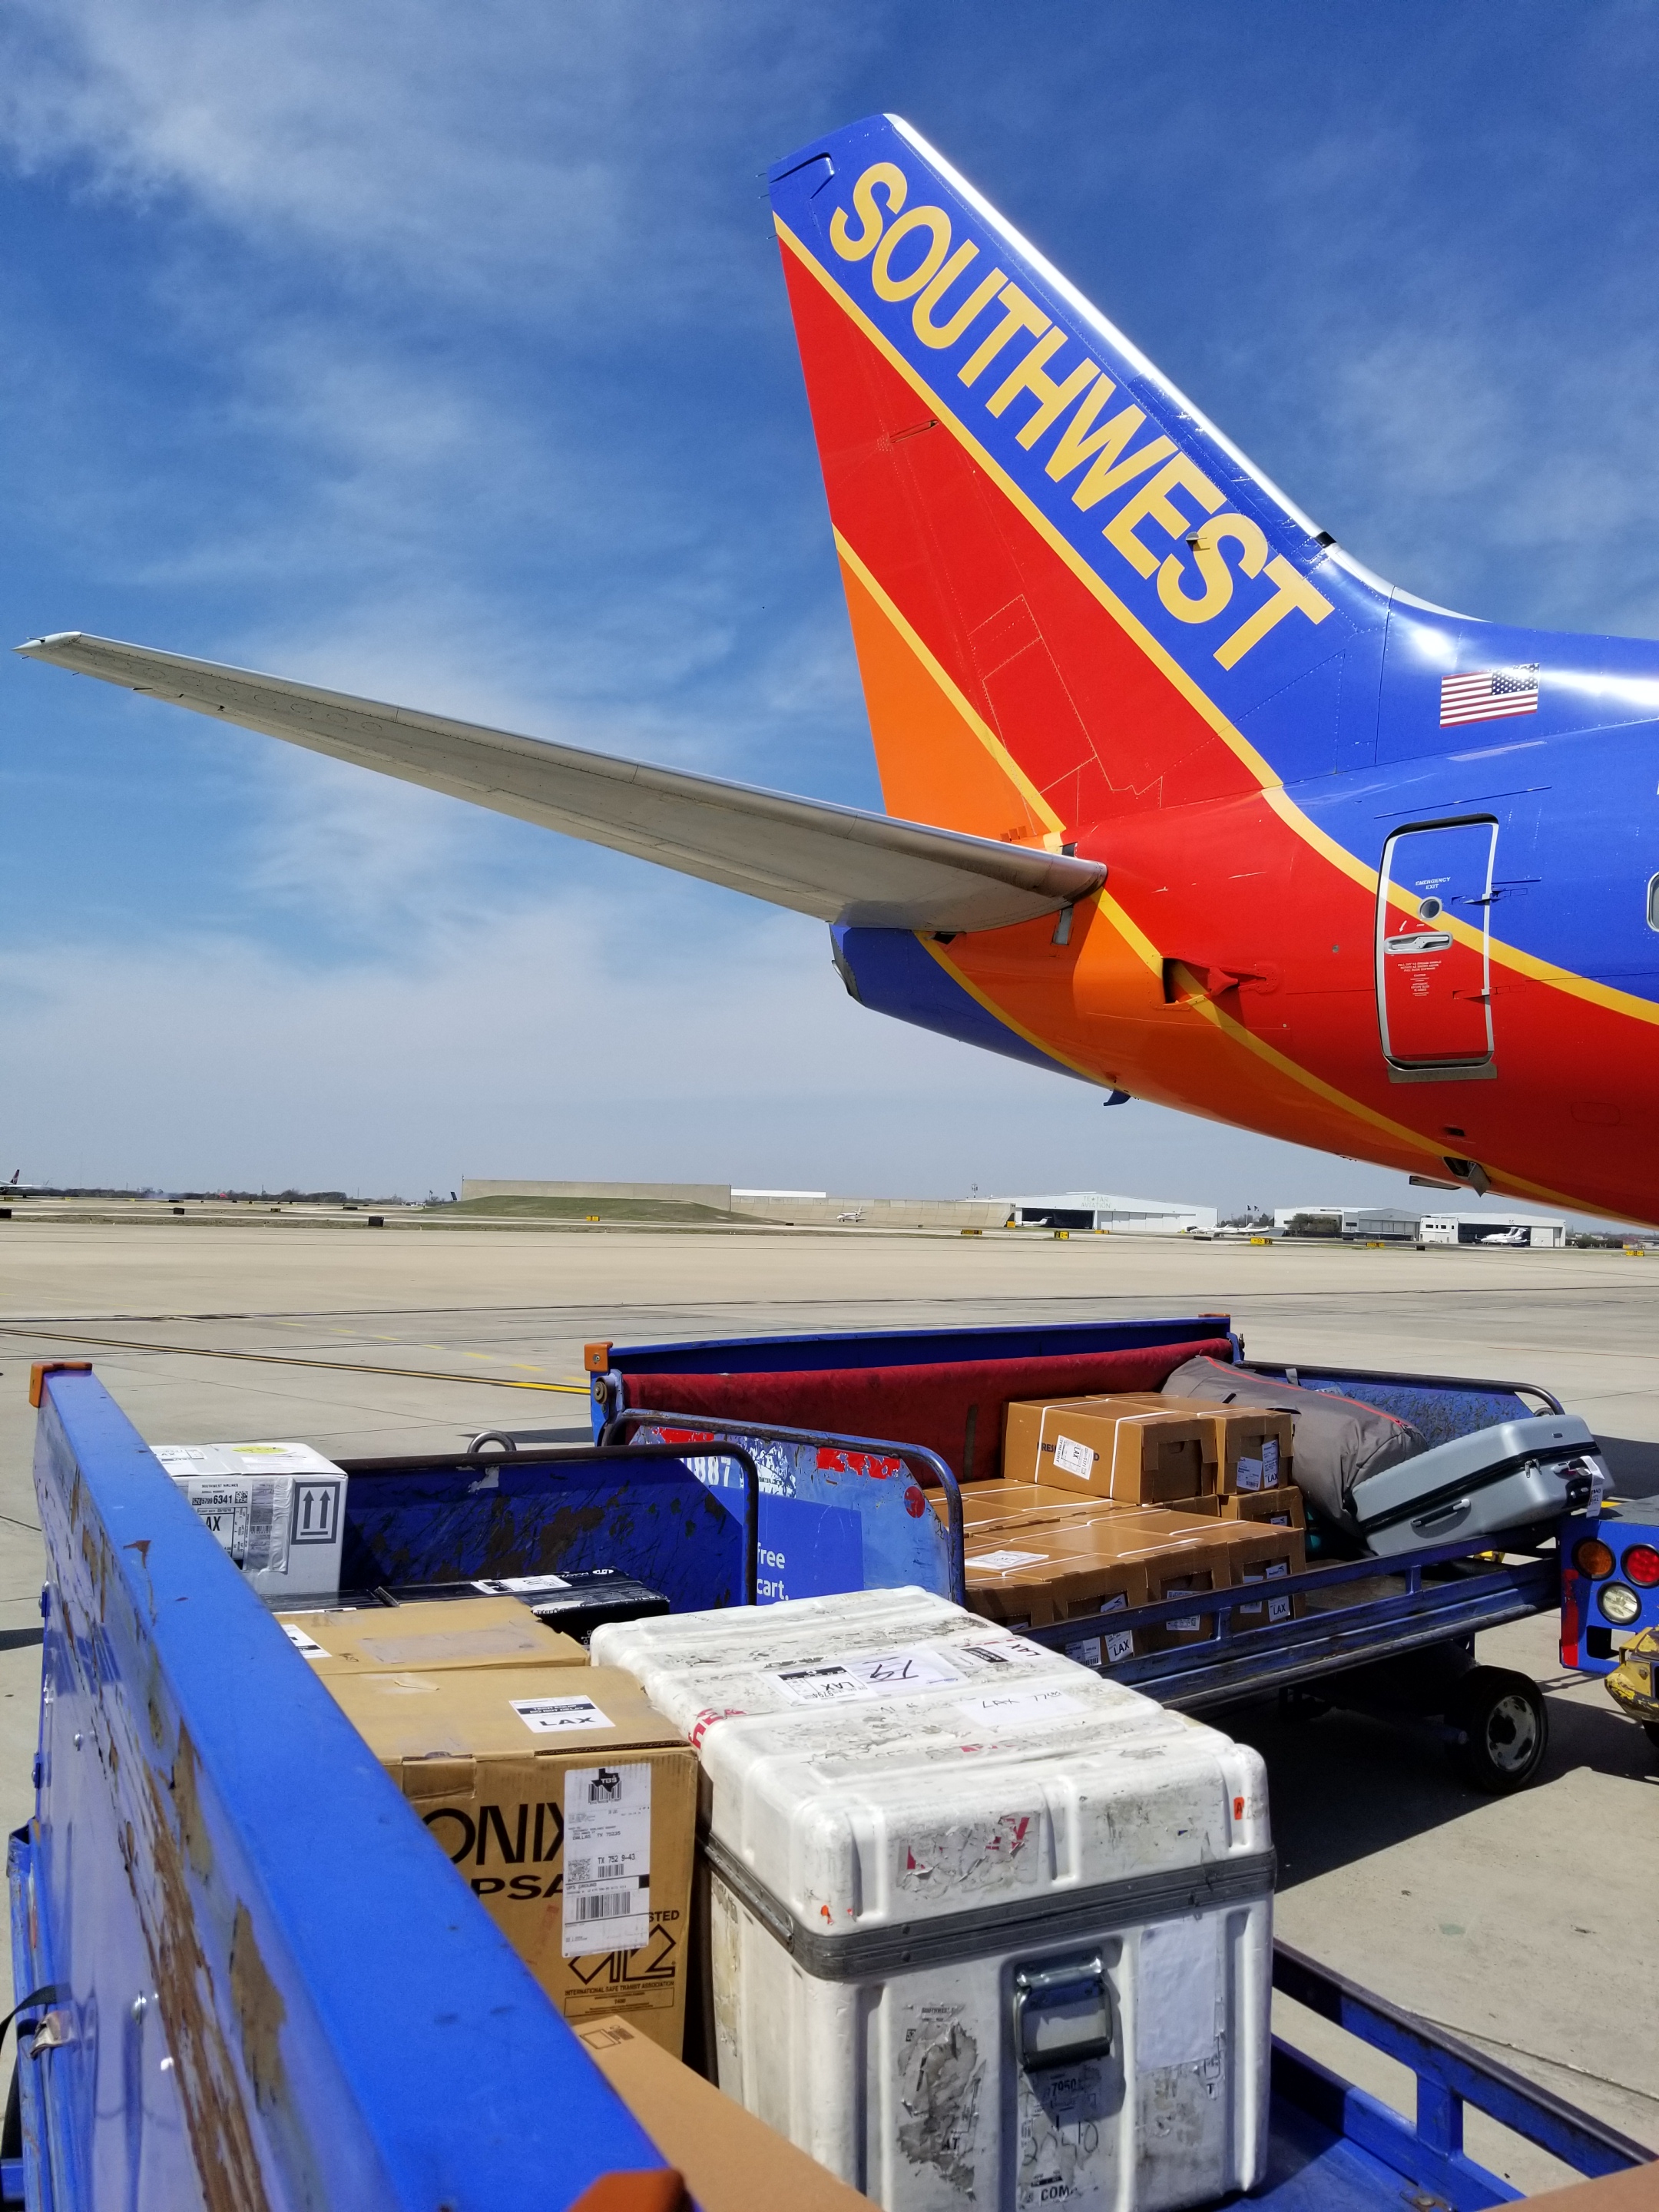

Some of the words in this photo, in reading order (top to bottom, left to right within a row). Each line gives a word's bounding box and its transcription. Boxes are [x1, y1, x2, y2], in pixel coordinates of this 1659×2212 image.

[830, 162, 1335, 671] SOUTHWEST
[1415, 877, 1451, 886] EMERGENCY
[1072, 1446, 1081, 1459] LAX
[1267, 1473, 1278, 1483] LAX
[192, 1497, 201, 1505] 526
[213, 1495, 233, 1504] 6341
[757, 1542, 785, 1569] free
[757, 1577, 789, 1601] cart.
[1273, 1604, 1286, 1615] LAX
[1005, 1644, 1041, 1657] LAX
[1114, 1639, 1130, 1657] LAX
[820, 1681, 855, 1691] LAX
[812, 1691, 834, 1700] 9794
[982, 1699, 1020, 1708] LAX
[539, 1717, 596, 1726] LAX
[565, 1987, 604, 1995] INTERNATIONAL
